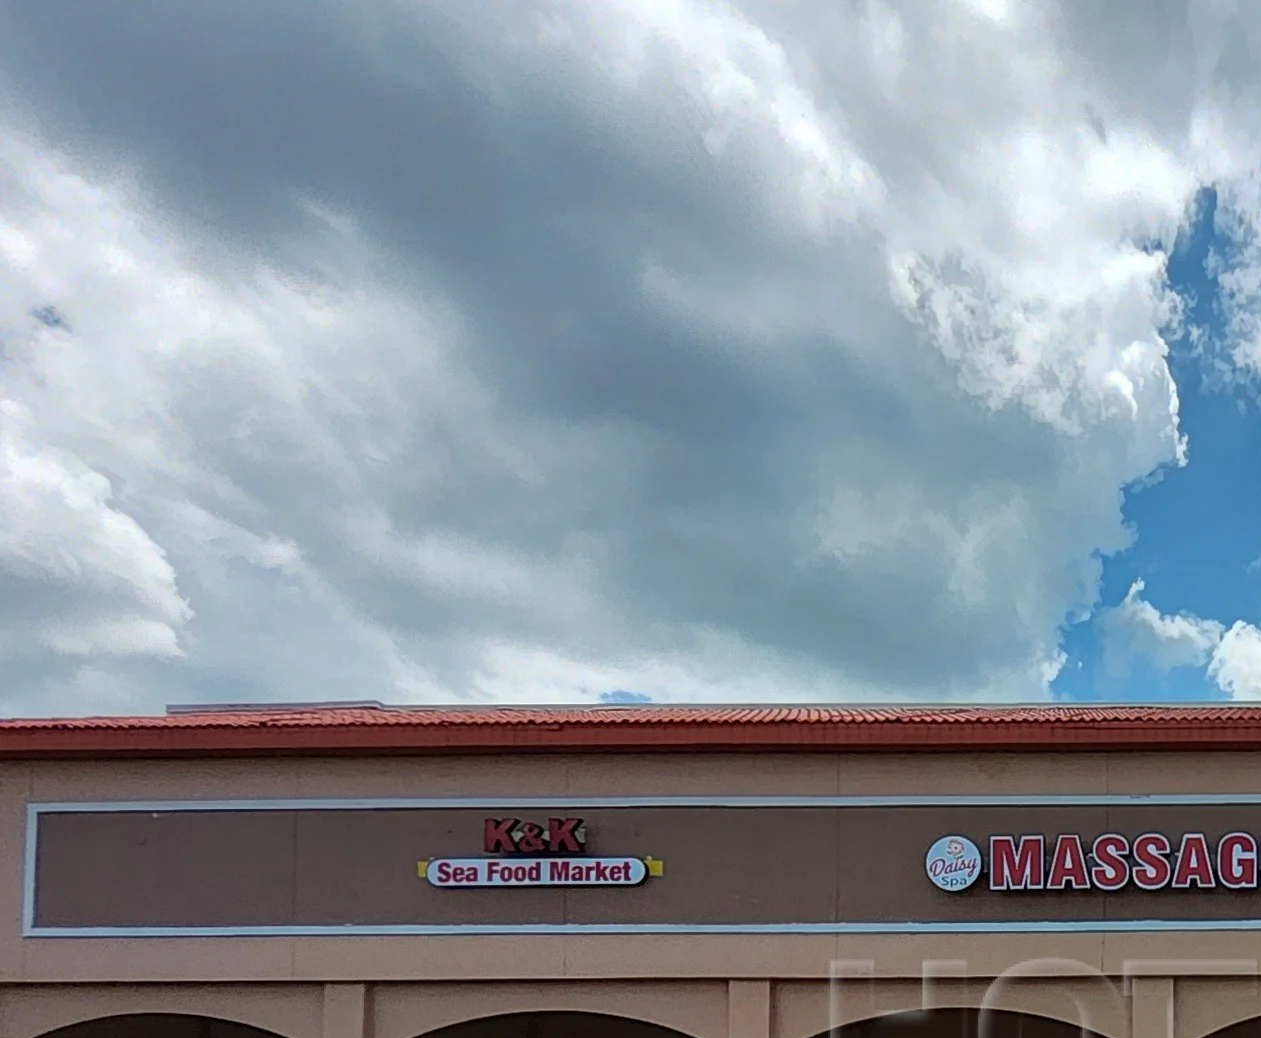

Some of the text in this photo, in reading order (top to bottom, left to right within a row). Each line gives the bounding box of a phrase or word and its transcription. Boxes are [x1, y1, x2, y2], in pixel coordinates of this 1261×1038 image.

[484, 818, 583, 853] K&K
[437, 860, 632, 883] Sea Food Market
[929, 858, 978, 878] Daisy
[941, 876, 968, 889] Spa
